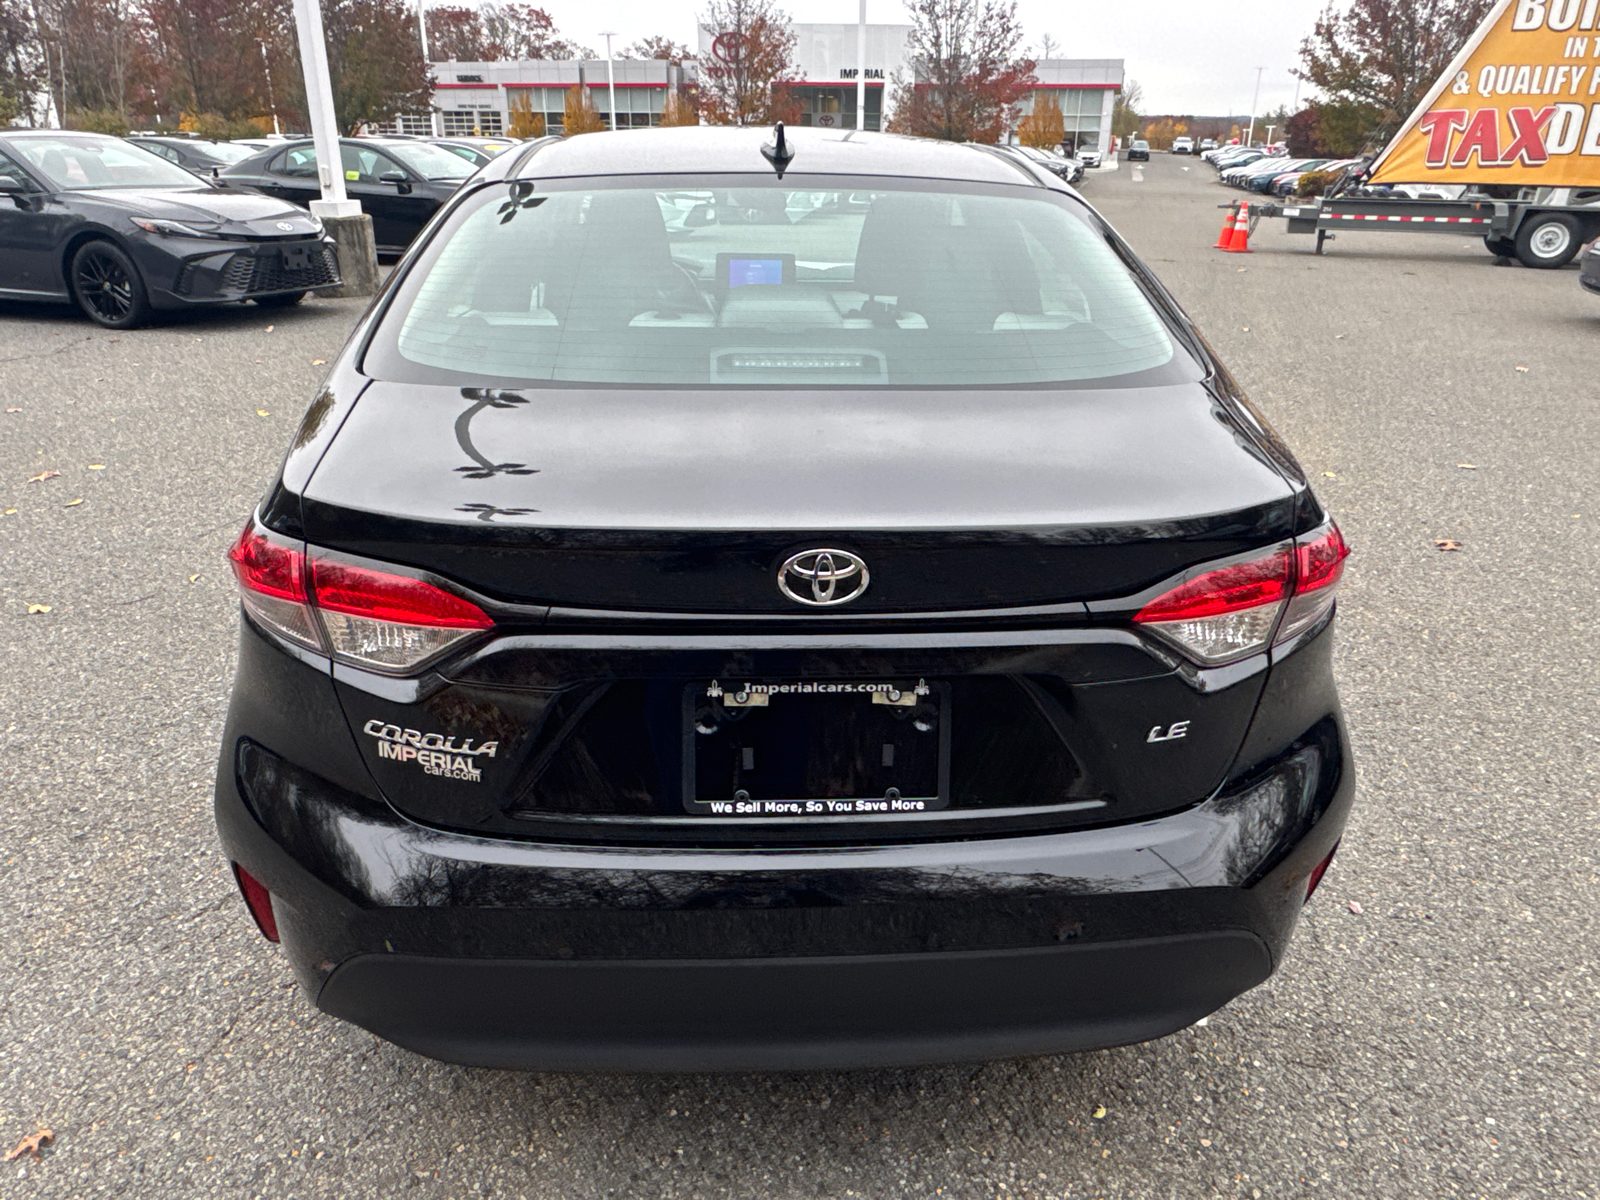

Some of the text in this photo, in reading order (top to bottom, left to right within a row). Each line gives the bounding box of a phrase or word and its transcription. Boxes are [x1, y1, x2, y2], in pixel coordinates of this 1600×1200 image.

[1511, 0, 1600, 31] BUI
[1563, 36, 1588, 58] IN
[840, 69, 885, 79] IMPRIAL
[1452, 70, 1470, 95] &
[1477, 65, 1587, 97] QUALIFY
[1420, 107, 1558, 167] TAX
[743, 682, 894, 695] Imperialcars.com
[363, 719, 499, 757] COROLLA
[1146, 720, 1190, 743] LE
[378, 740, 482, 774] IMPERIAL
[424, 765, 481, 782] cars.com
[711, 800, 924, 815] We Sell More, So You Save More
